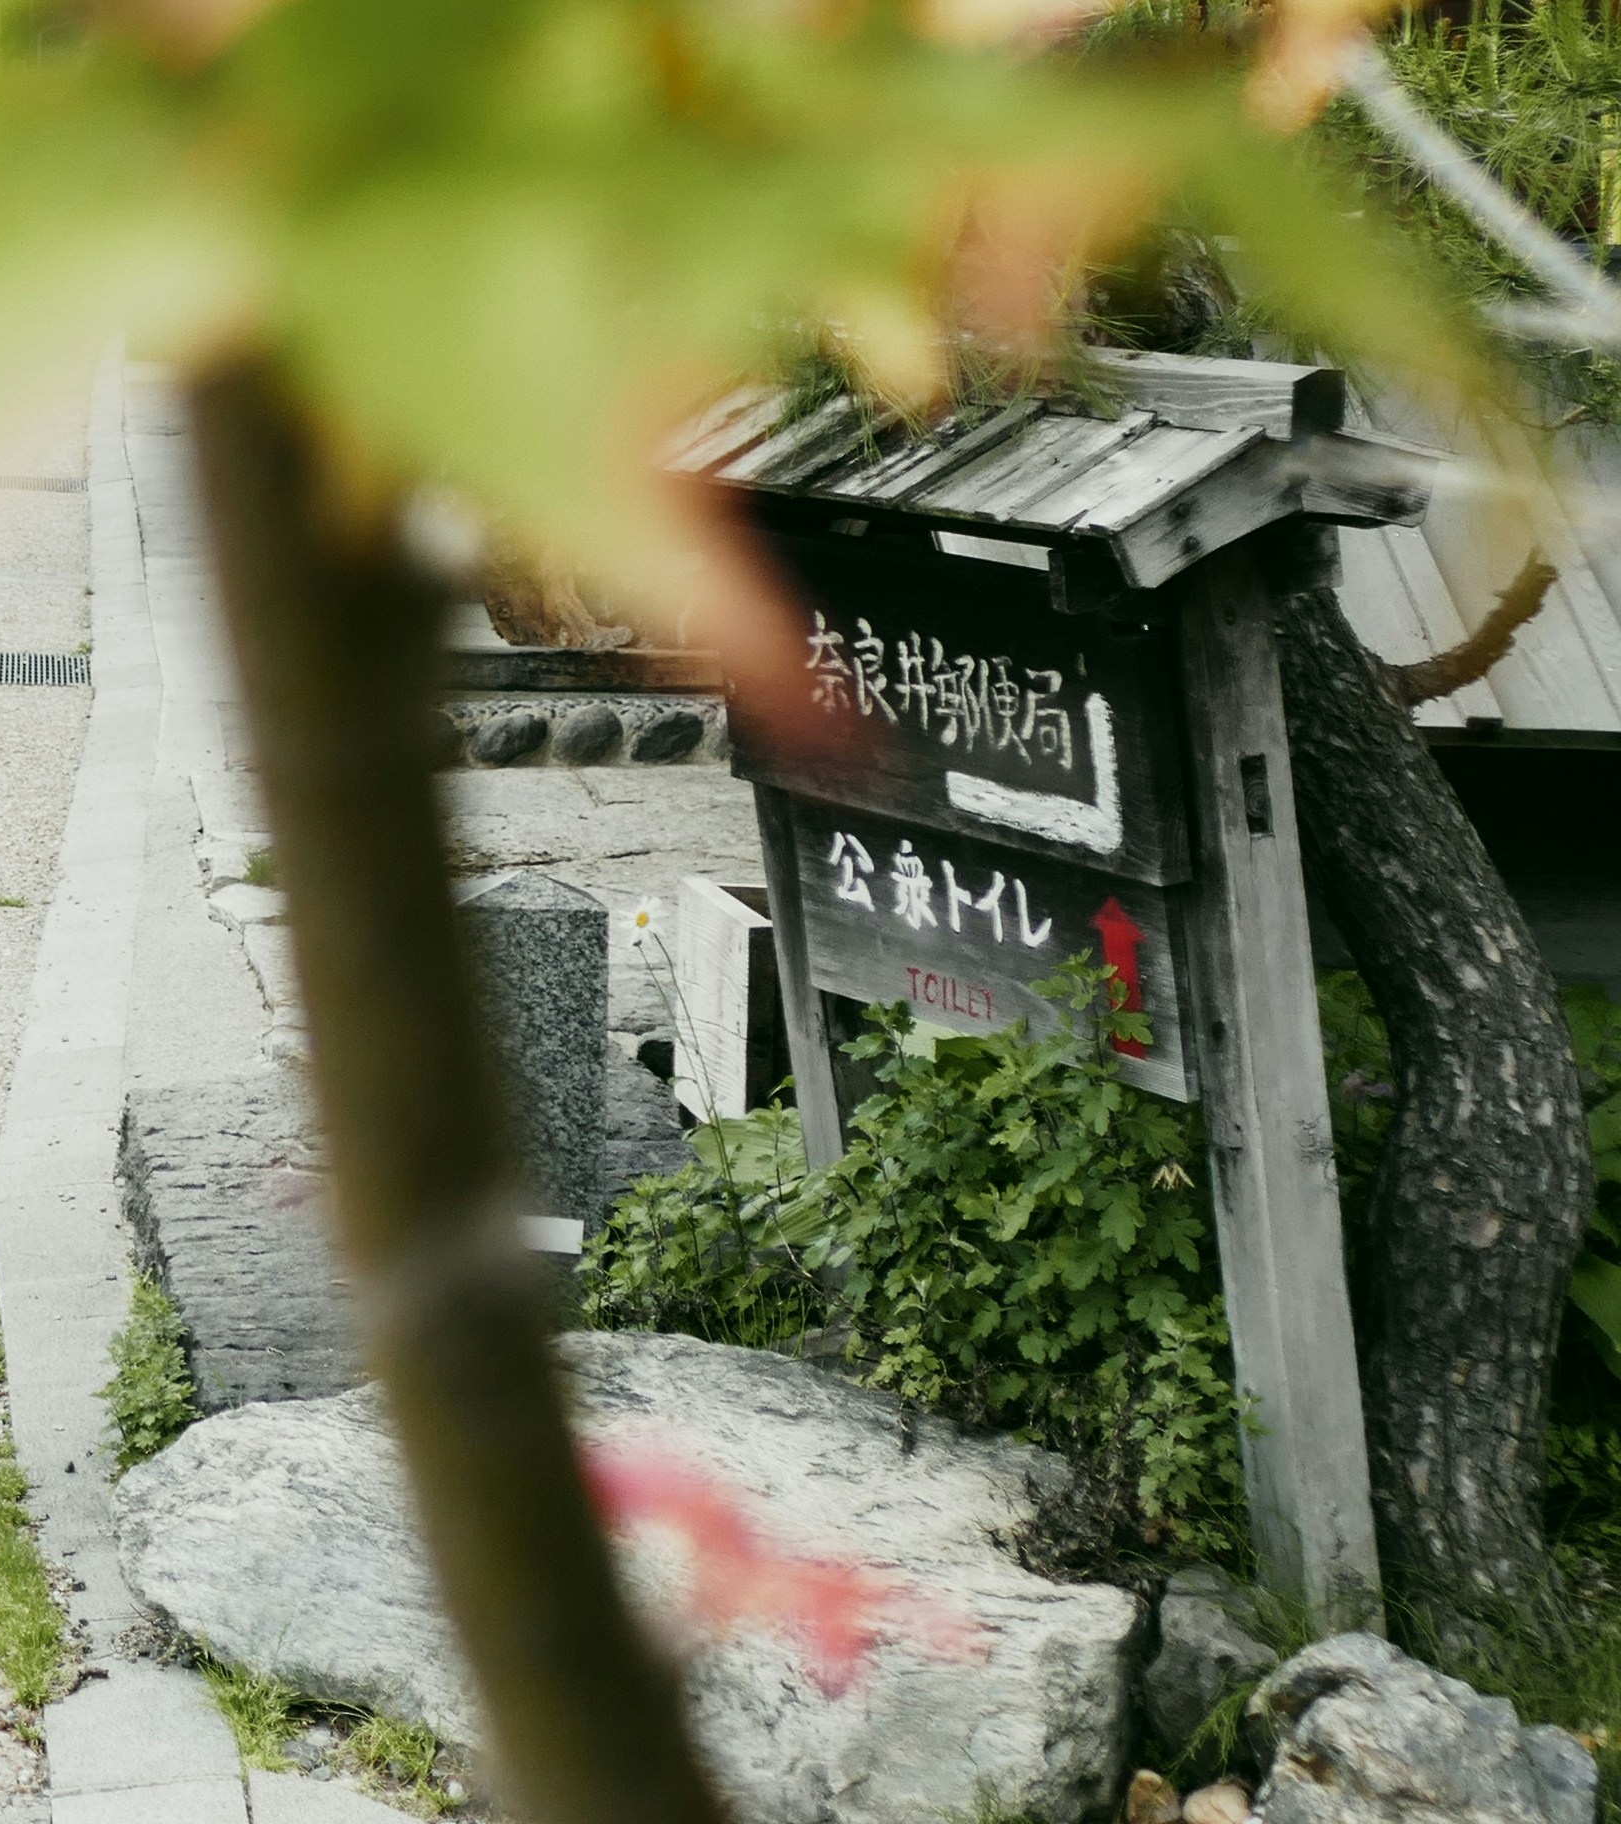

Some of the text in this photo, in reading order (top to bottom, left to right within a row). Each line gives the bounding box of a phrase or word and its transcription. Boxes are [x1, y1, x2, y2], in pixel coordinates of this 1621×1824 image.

[805, 609, 1073, 773] 奈良井郵便局
[828, 831, 1053, 949] 公衆トイレ
[906, 966, 995, 1020] TOILET
